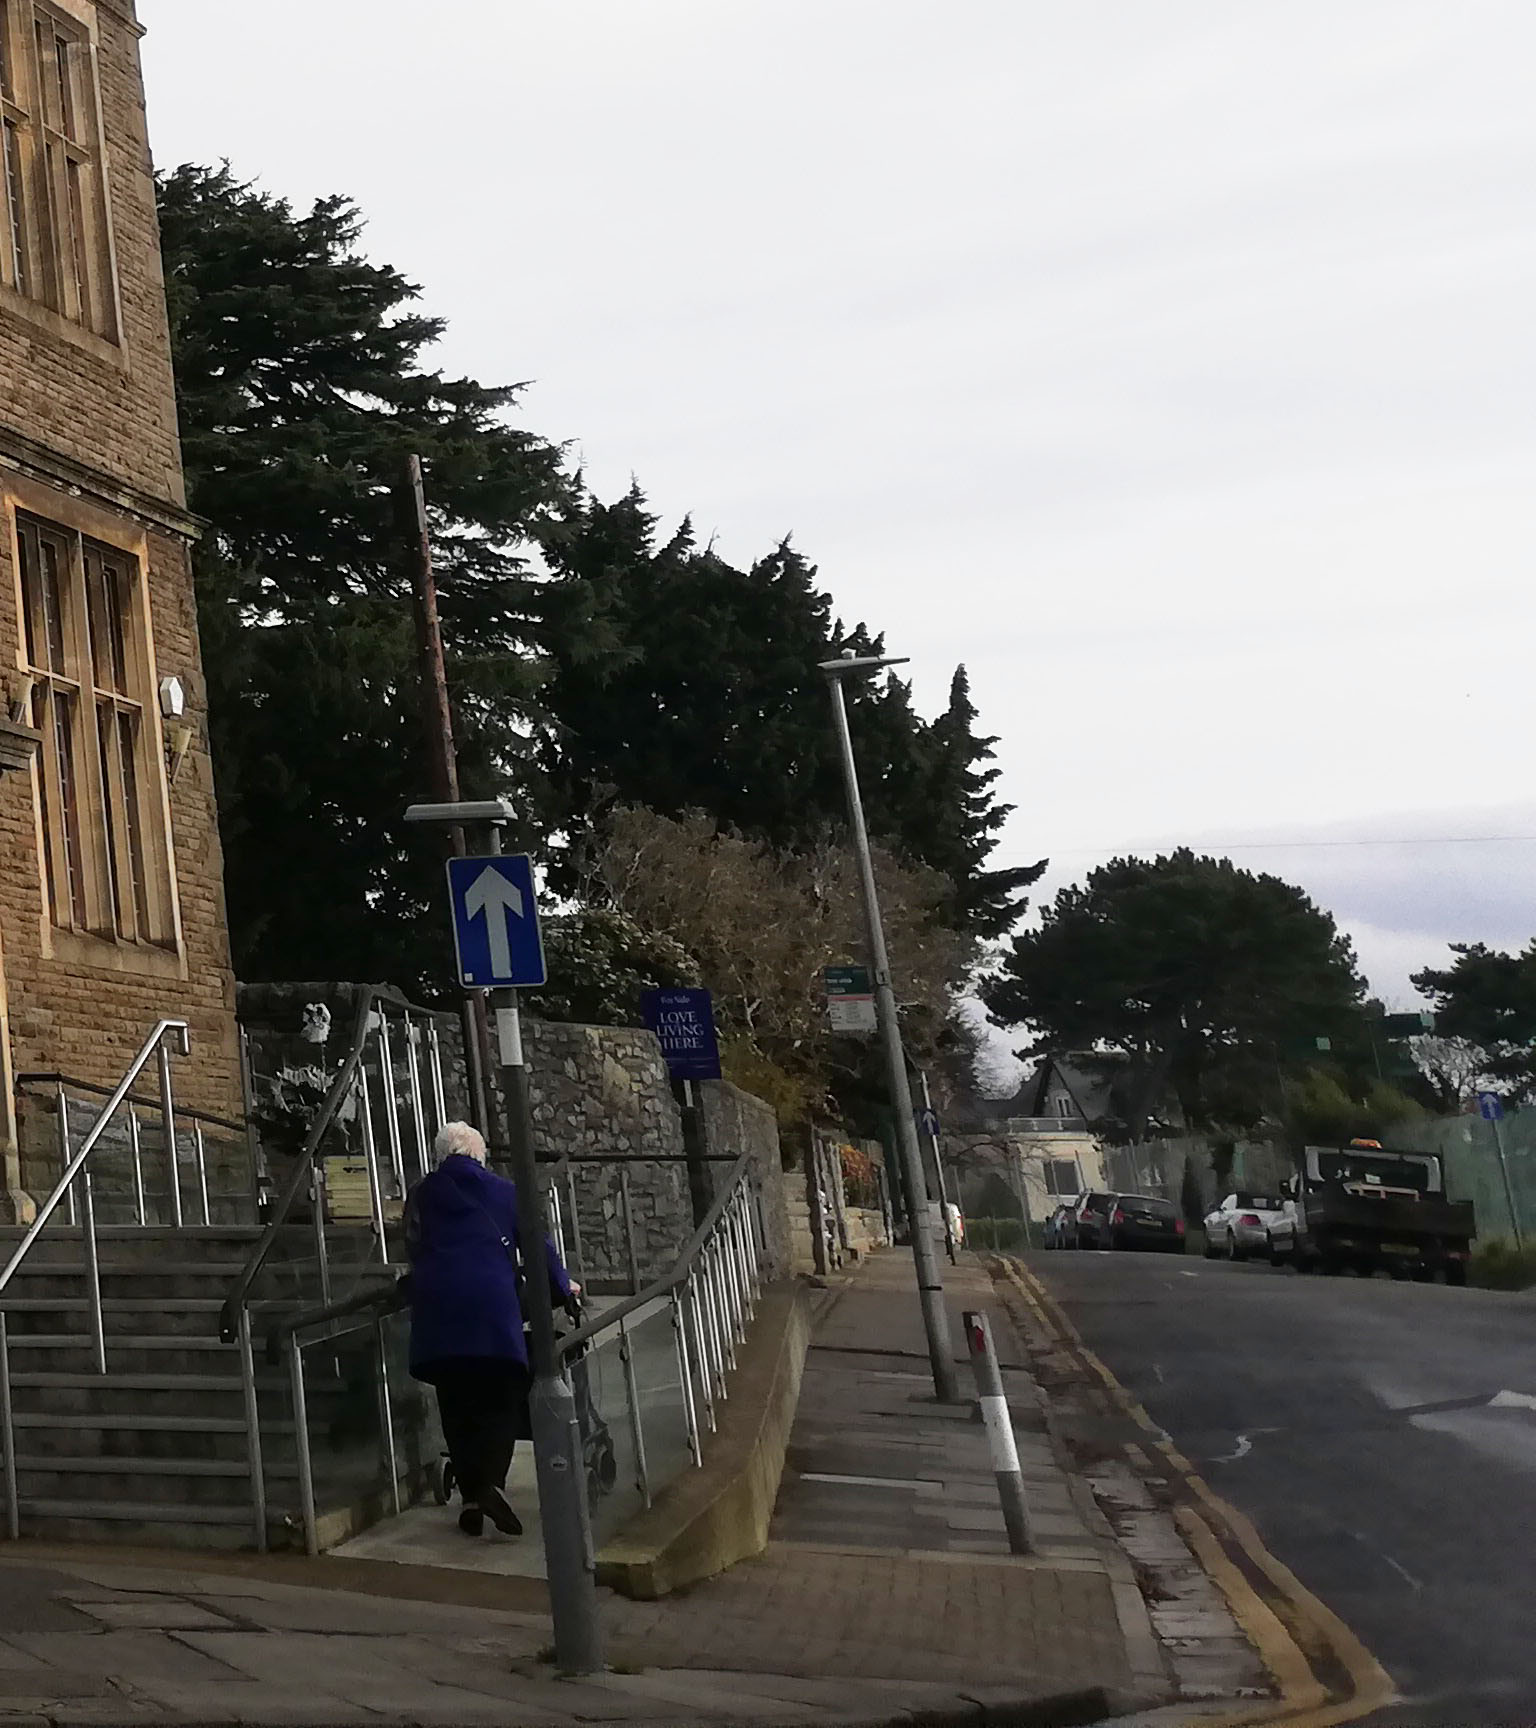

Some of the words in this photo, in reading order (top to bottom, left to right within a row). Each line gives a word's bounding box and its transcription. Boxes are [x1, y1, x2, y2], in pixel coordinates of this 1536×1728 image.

[659, 1011, 698, 1024] LOVE
[656, 1023, 705, 1037] LIVING
[663, 1037, 705, 1049] HERE
